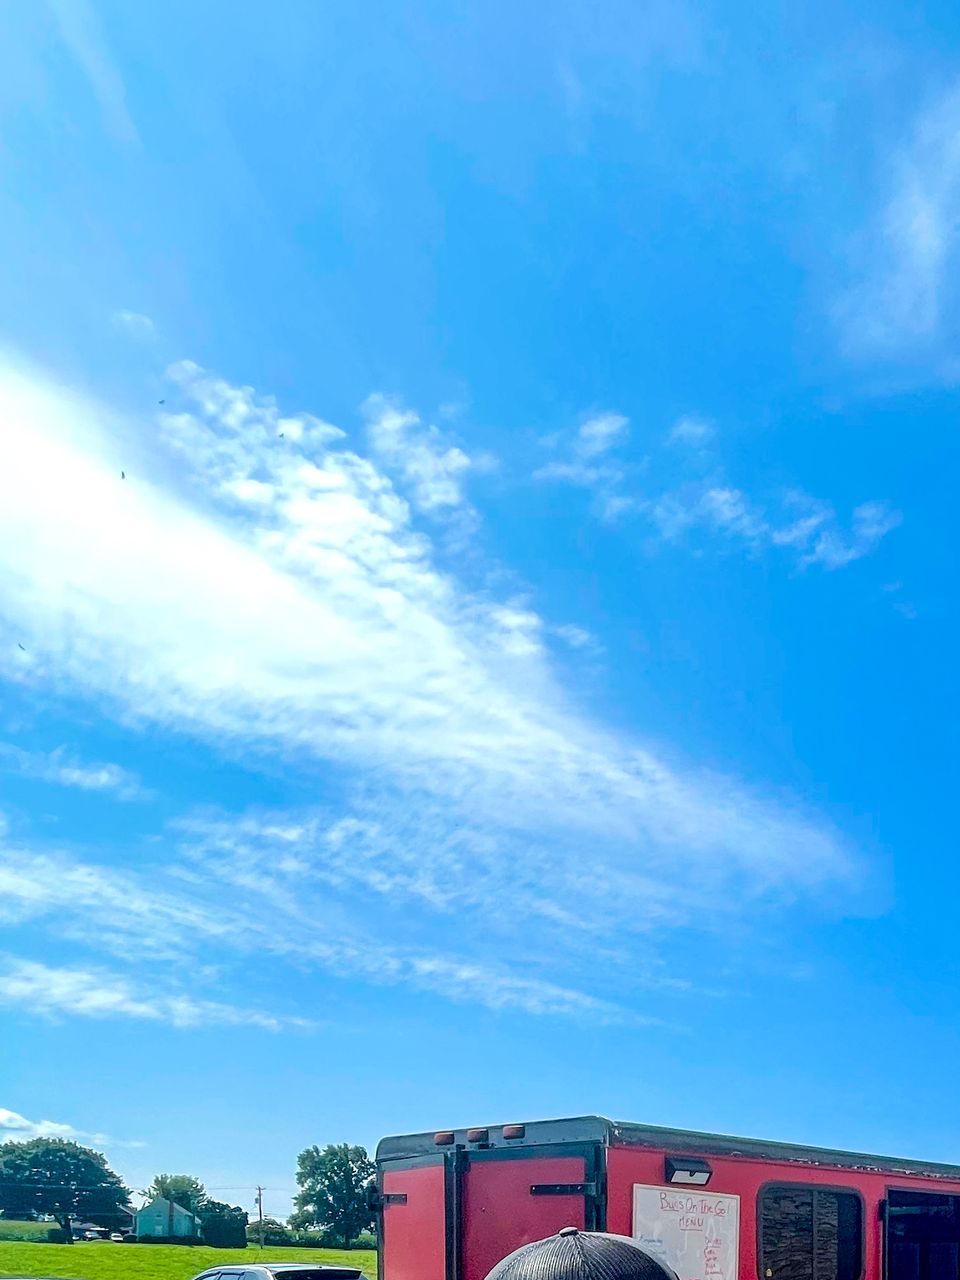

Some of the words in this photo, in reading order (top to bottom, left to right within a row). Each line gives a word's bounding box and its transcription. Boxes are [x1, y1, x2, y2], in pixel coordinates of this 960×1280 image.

[685, 1197, 698, 1212] On
[699, 1199, 714, 1214] The
[679, 1216, 705, 1228] MENU
